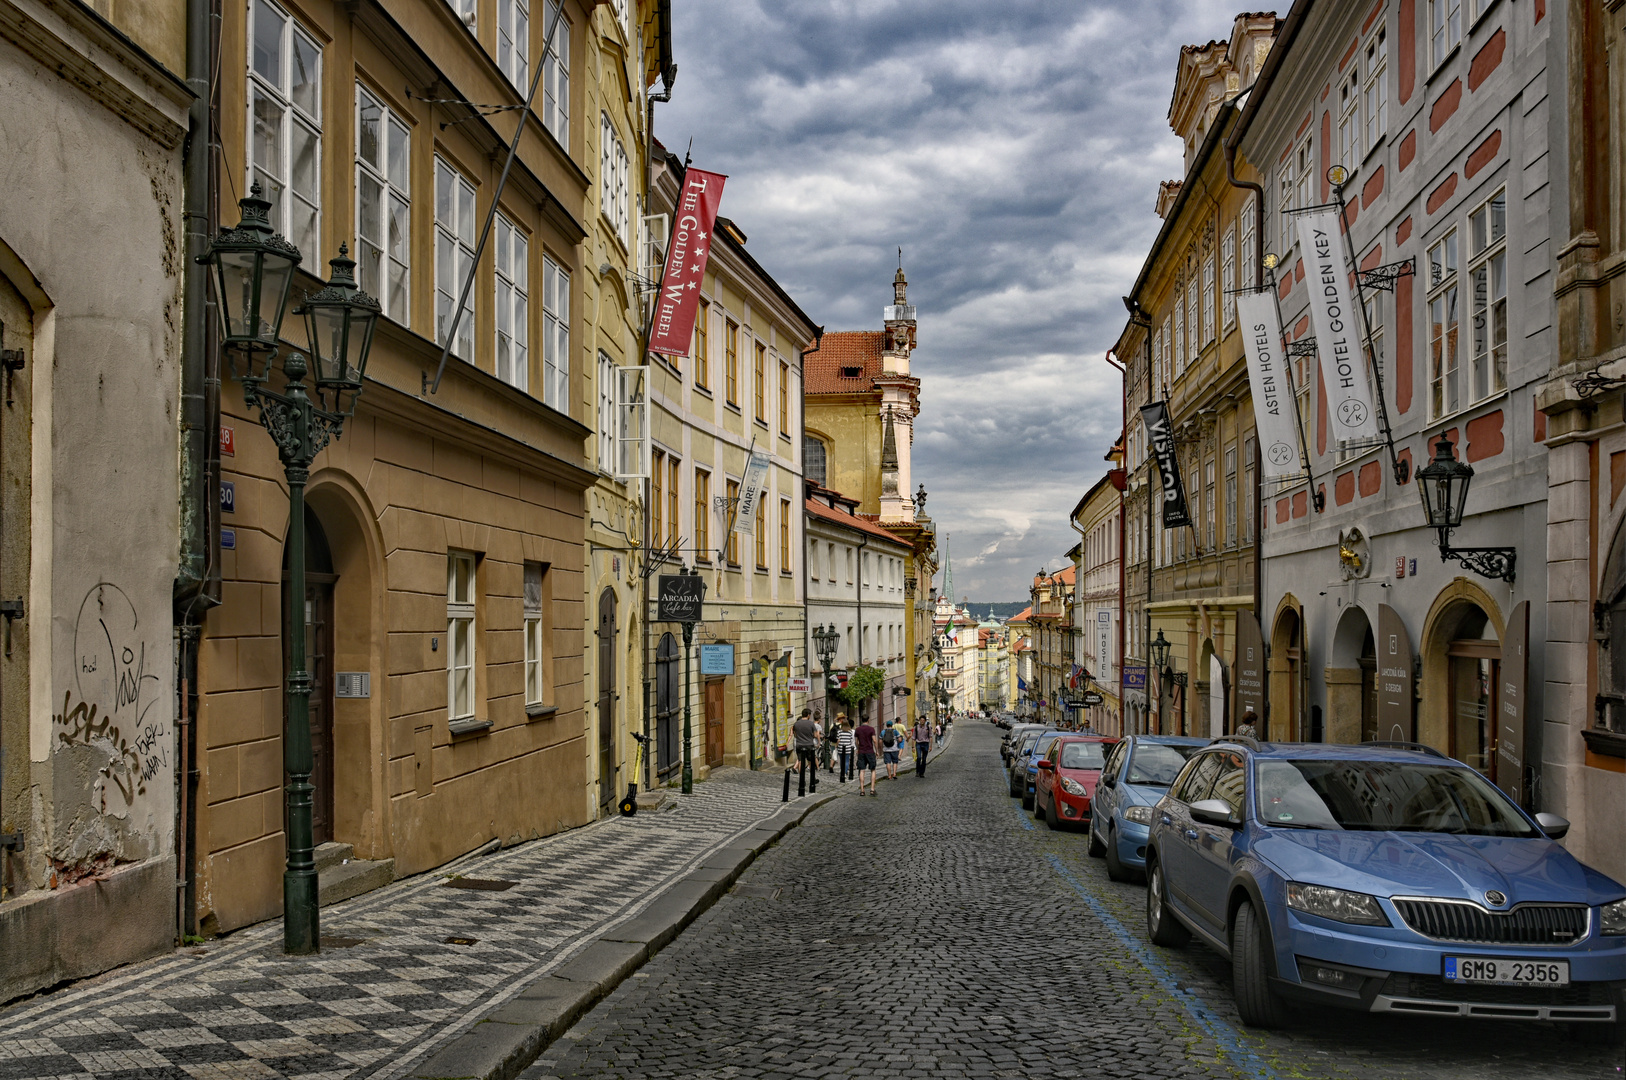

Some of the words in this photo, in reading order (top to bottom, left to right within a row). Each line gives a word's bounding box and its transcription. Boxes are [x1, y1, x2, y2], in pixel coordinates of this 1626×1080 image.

[683, 179, 708, 212] THE
[669, 215, 698, 279] GOLDEN
[1313, 229, 1331, 259] KEY
[656, 283, 685, 339] WHEEL
[1321, 264, 1344, 333] GOLDEN
[1254, 323, 1273, 373] HOTELS
[1334, 337, 1354, 389] HOTEL
[1264, 375, 1280, 416] ASTEN
[220, 430, 230, 444] 18
[1149, 418, 1178, 502] VISITOR
[661, 593, 700, 602] ARCADIA
[1129, 675, 1144, 684] 0%
[1461, 961, 1497, 980] 6M9
[1512, 963, 1559, 982] 2356
